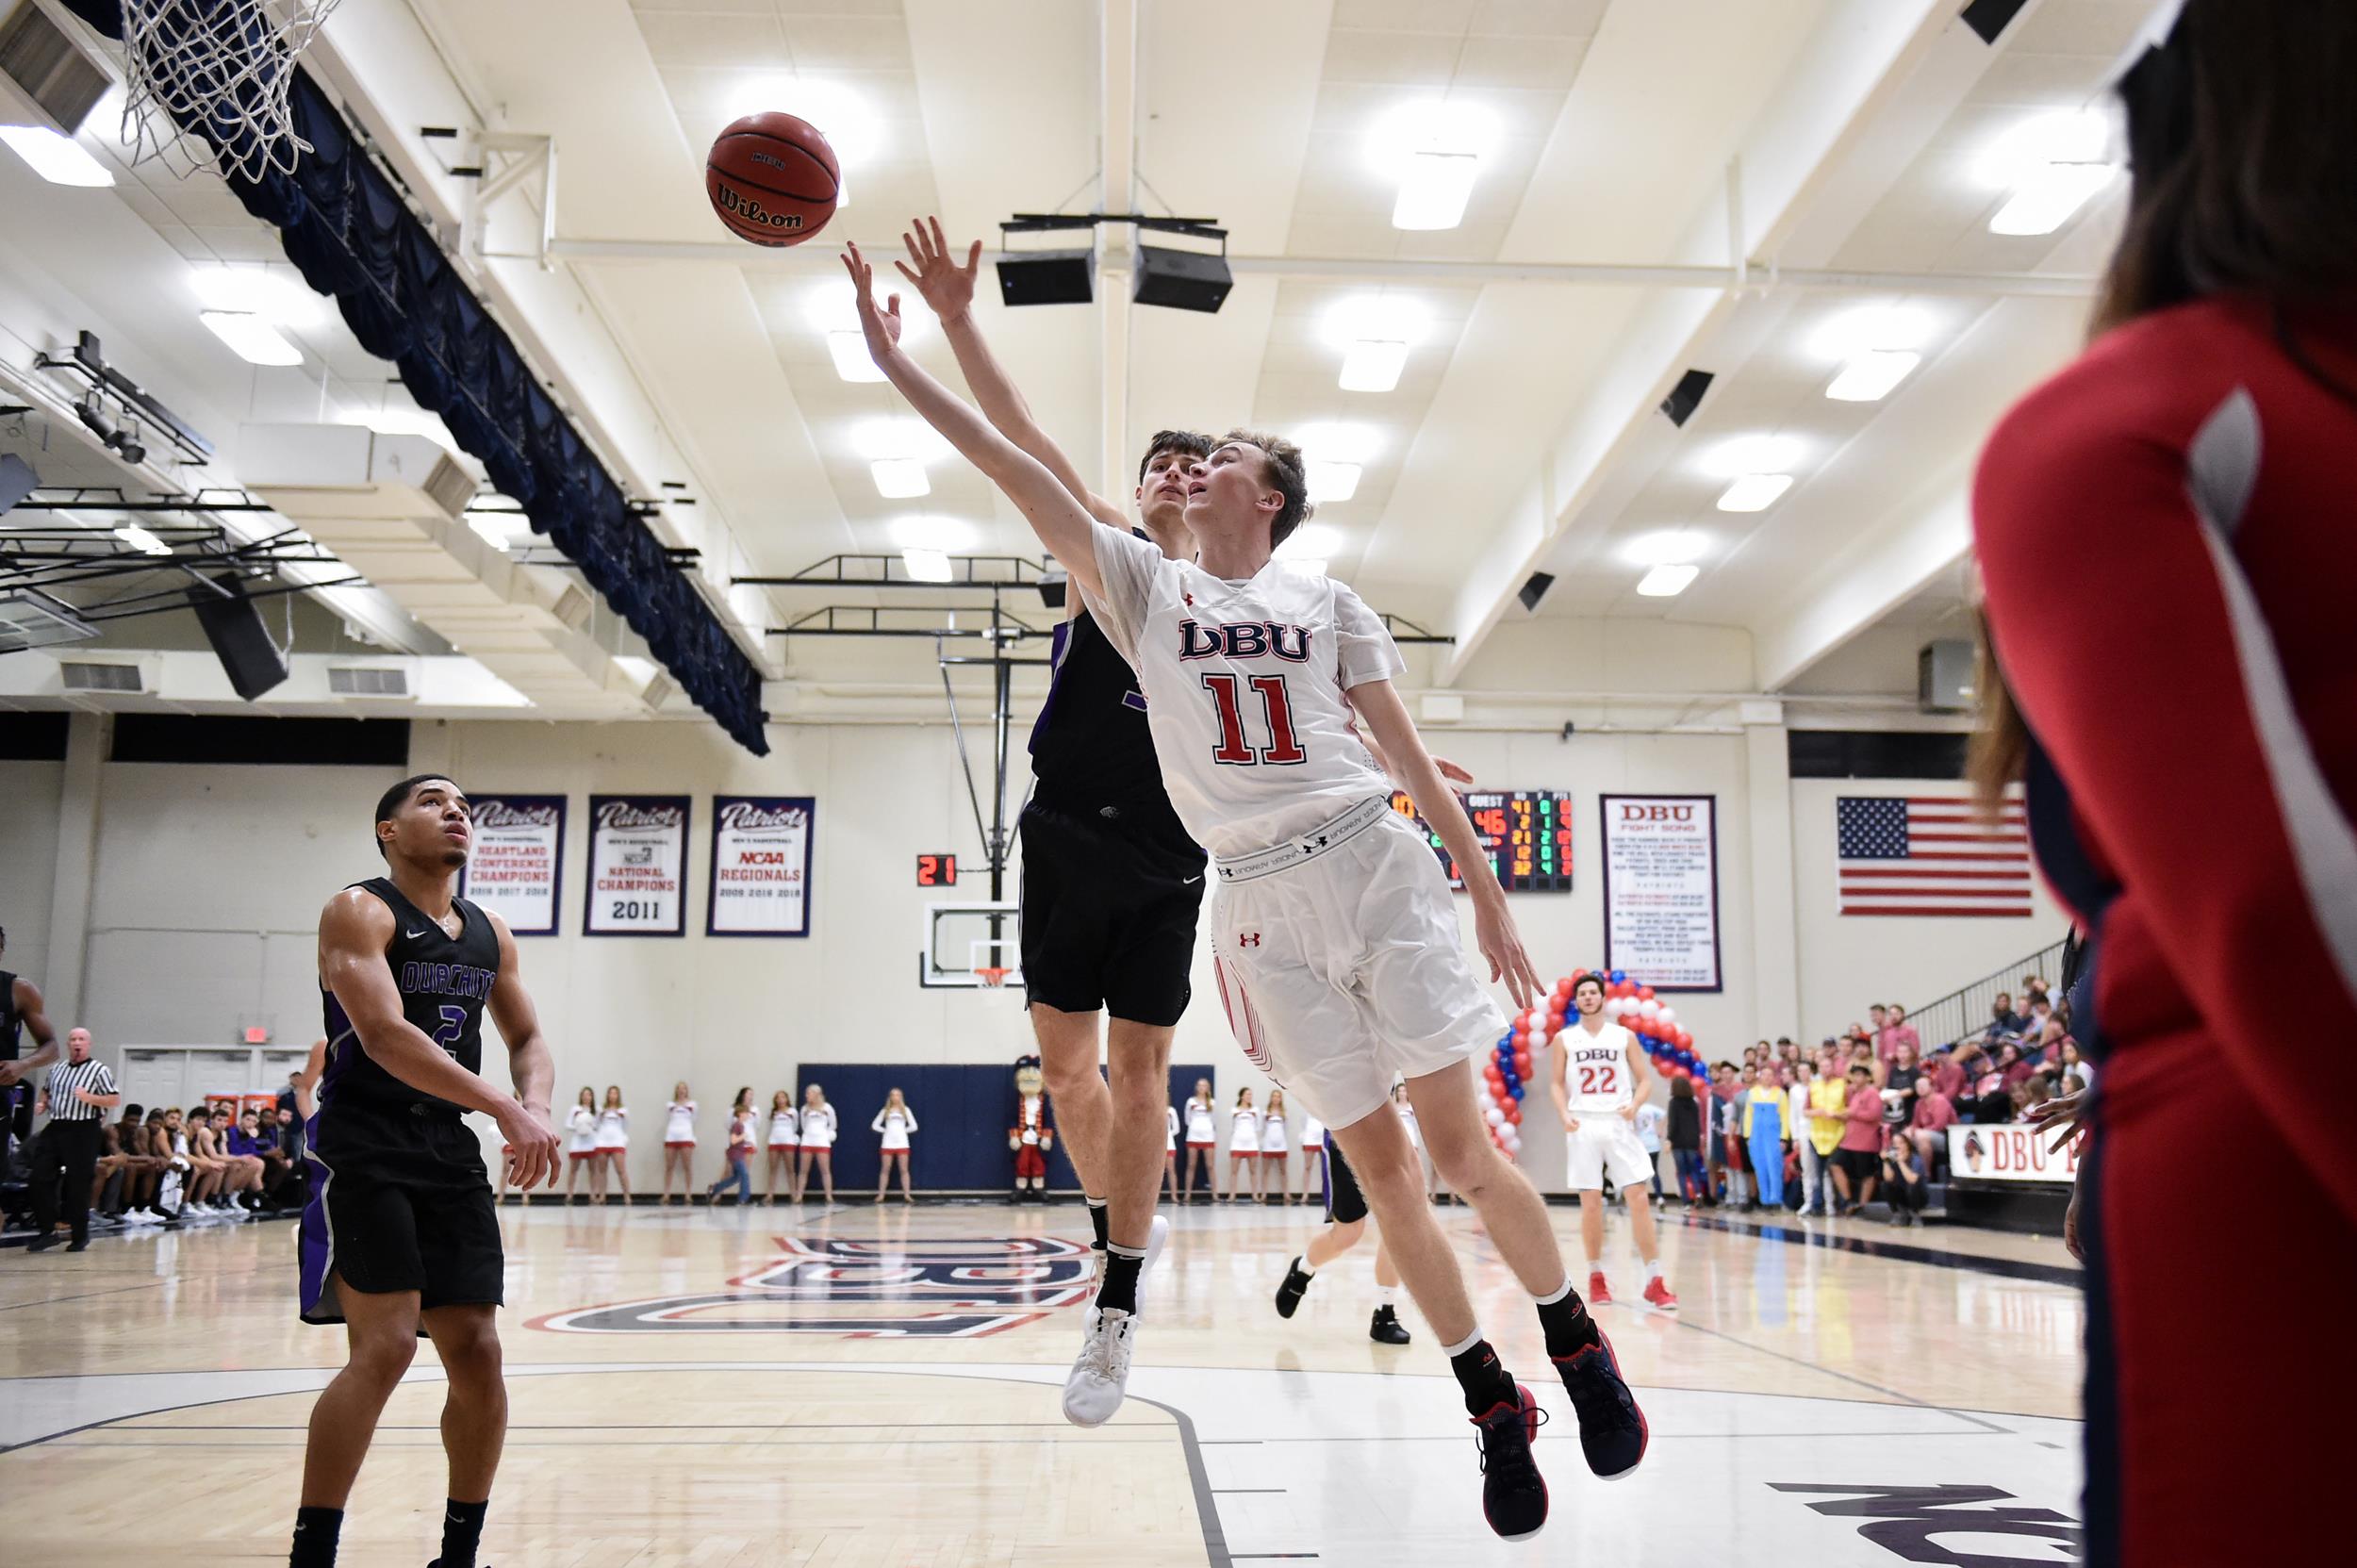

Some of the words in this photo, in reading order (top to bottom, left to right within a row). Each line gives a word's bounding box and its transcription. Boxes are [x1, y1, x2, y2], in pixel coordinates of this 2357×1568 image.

[717, 182, 802, 229] Wilson
[1178, 618, 1312, 664] DBU
[1201, 671, 1308, 766] 11
[1363, 800, 1384, 818] UNDER
[1468, 794, 1504, 807] GUEST
[471, 801, 558, 830] Patriots
[598, 801, 683, 831] Patriots
[721, 801, 807, 832] Patriots
[1475, 808, 1507, 834] 46
[1622, 805, 1694, 821] DBU
[1329, 816, 1362, 839] ARMOUR
[1621, 823, 1656, 833] FIGHT
[1661, 823, 1696, 833] SONG
[478, 846, 547, 856] HEARTLAND
[739, 851, 784, 865] NCAA
[472, 859, 550, 869] CONFERENCE
[609, 867, 665, 878] NATIONAL
[918, 856, 955, 885] 21
[1235, 861, 1269, 875] ARMOUR
[471, 871, 550, 883] CHAMPIONS
[720, 868, 801, 883] REGIONALS
[597, 879, 676, 892] CHAMPIONS
[613, 900, 659, 920] 2011
[432, 1005, 468, 1062] 2
[1574, 1048, 1619, 1063] DBU
[1578, 1066, 1617, 1094] 22
[1992, 1131, 2046, 1171] DBU
